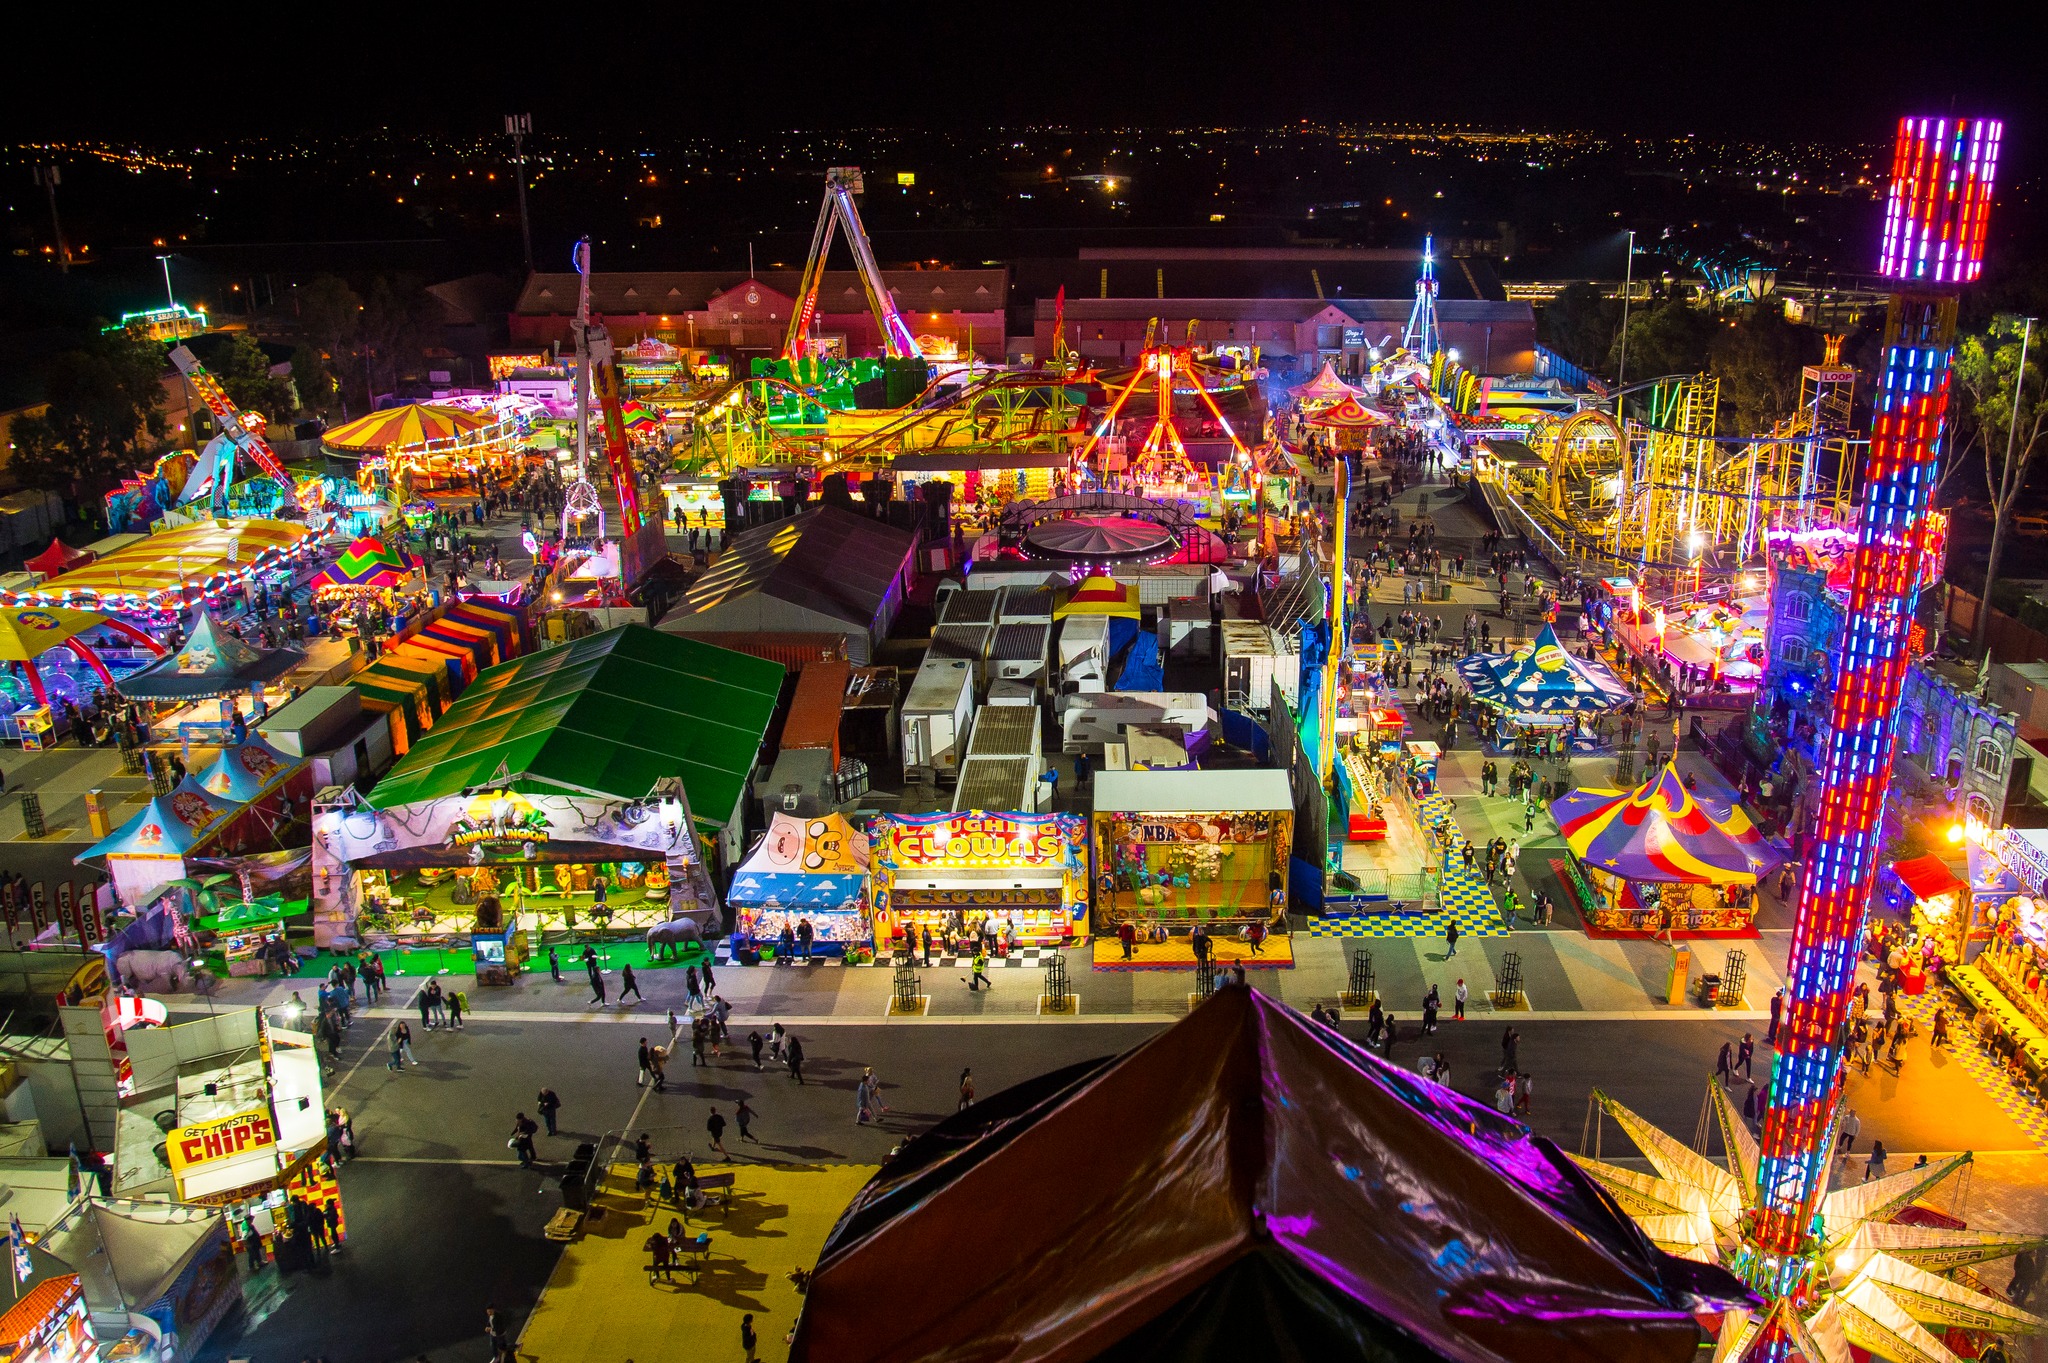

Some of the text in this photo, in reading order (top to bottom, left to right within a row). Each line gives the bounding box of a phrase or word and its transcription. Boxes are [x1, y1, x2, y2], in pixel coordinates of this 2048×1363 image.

[1824, 373, 1853, 381] LOOP
[900, 816, 1058, 837] LAUGHING
[1143, 824, 1176, 842] NBA
[454, 827, 496, 847] ANIMAL
[899, 835, 1060, 858] CLOWNS
[912, 890, 1042, 904] CLOWNS
[1676, 901, 1691, 912] WIN
[61, 892, 73, 927] FOOD
[1631, 914, 1718, 925] ANGY BIRDS
[82, 904, 97, 941] FOOD
[183, 1114, 260, 1138] GET TWISTED
[180, 1118, 272, 1164] CHIPS
[241, 1180, 273, 1195] CHIPS
[1919, 1249, 1985, 1265] FLYER
[1917, 1299, 1993, 1330] FLYER
